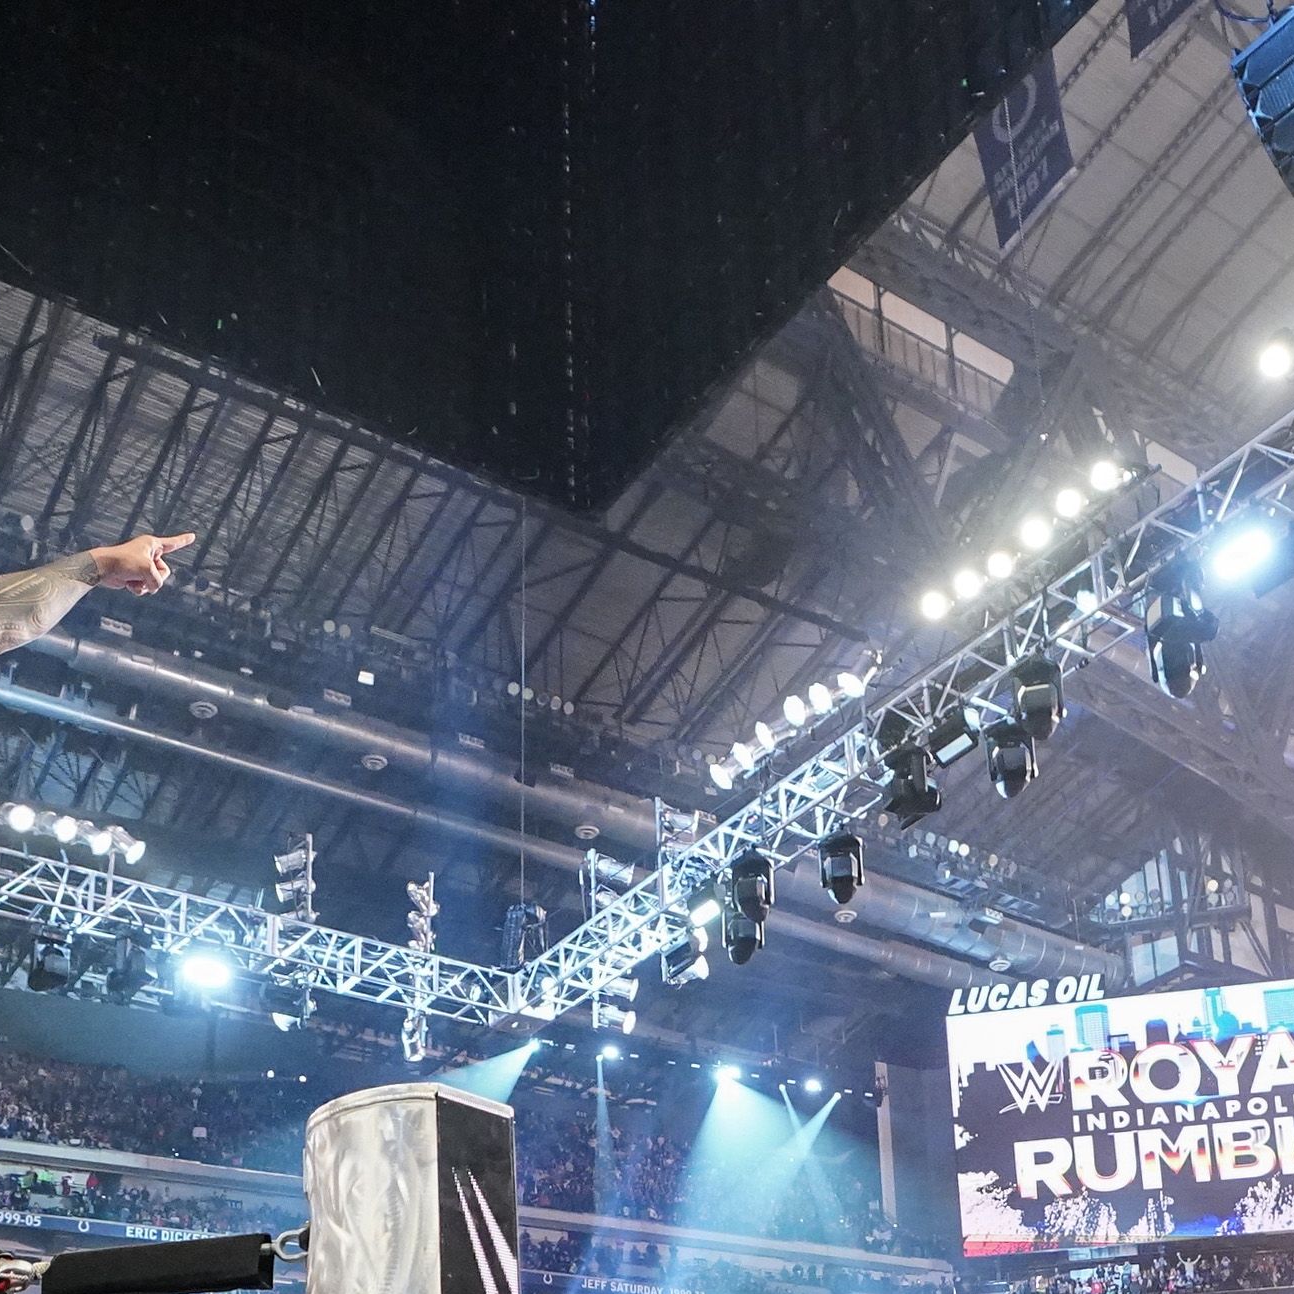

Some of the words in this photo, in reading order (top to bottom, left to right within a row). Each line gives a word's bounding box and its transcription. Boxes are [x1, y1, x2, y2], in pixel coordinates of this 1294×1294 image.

[949, 978, 1049, 1016] LUCAS
[1055, 973, 1106, 1002] OIL
[126, 1226, 158, 1241] ERIC
[582, 1278, 606, 1290] JEFF
